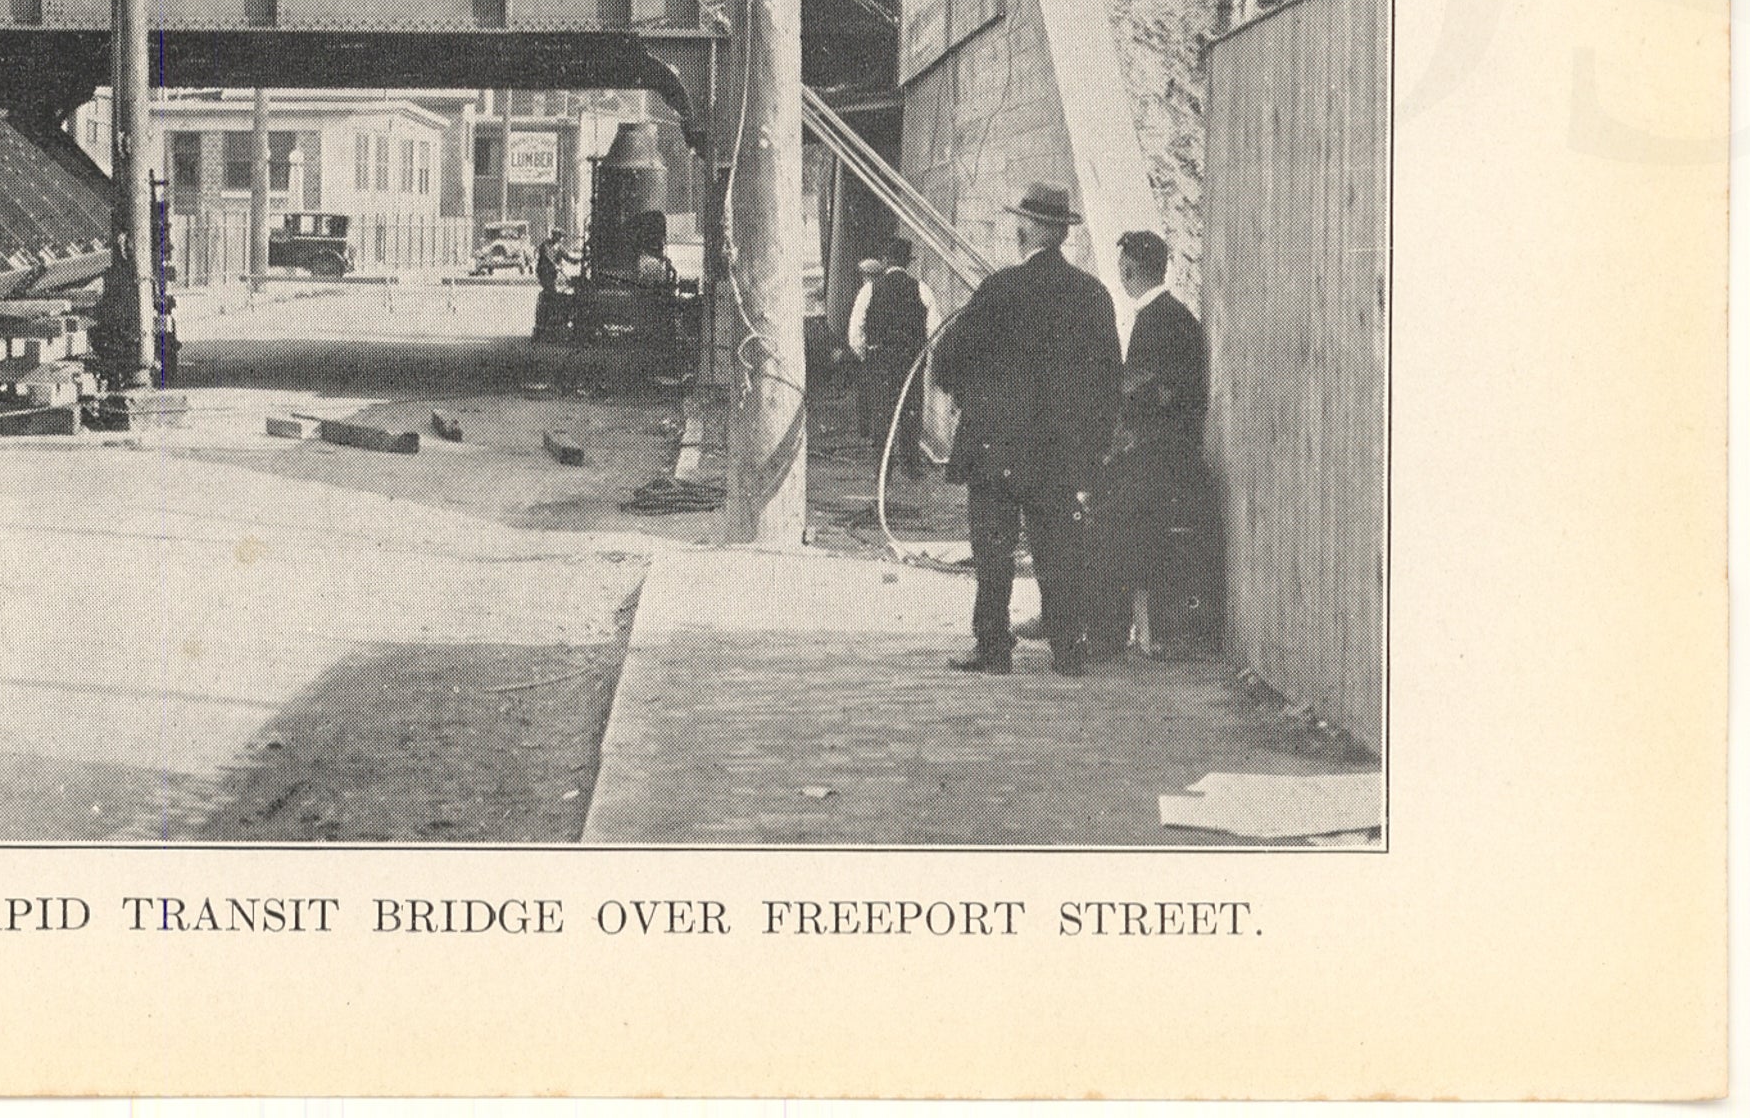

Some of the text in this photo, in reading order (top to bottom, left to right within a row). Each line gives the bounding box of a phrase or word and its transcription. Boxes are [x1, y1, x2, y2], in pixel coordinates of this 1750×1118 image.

[511, 151, 554, 168] LUMBER
[122, 898, 340, 932] TRANSIT
[374, 900, 565, 933] BRIDGE
[596, 900, 732, 934] OVER
[764, 902, 1026, 935] FREEPORT
[1059, 903, 1267, 936] STREET.
